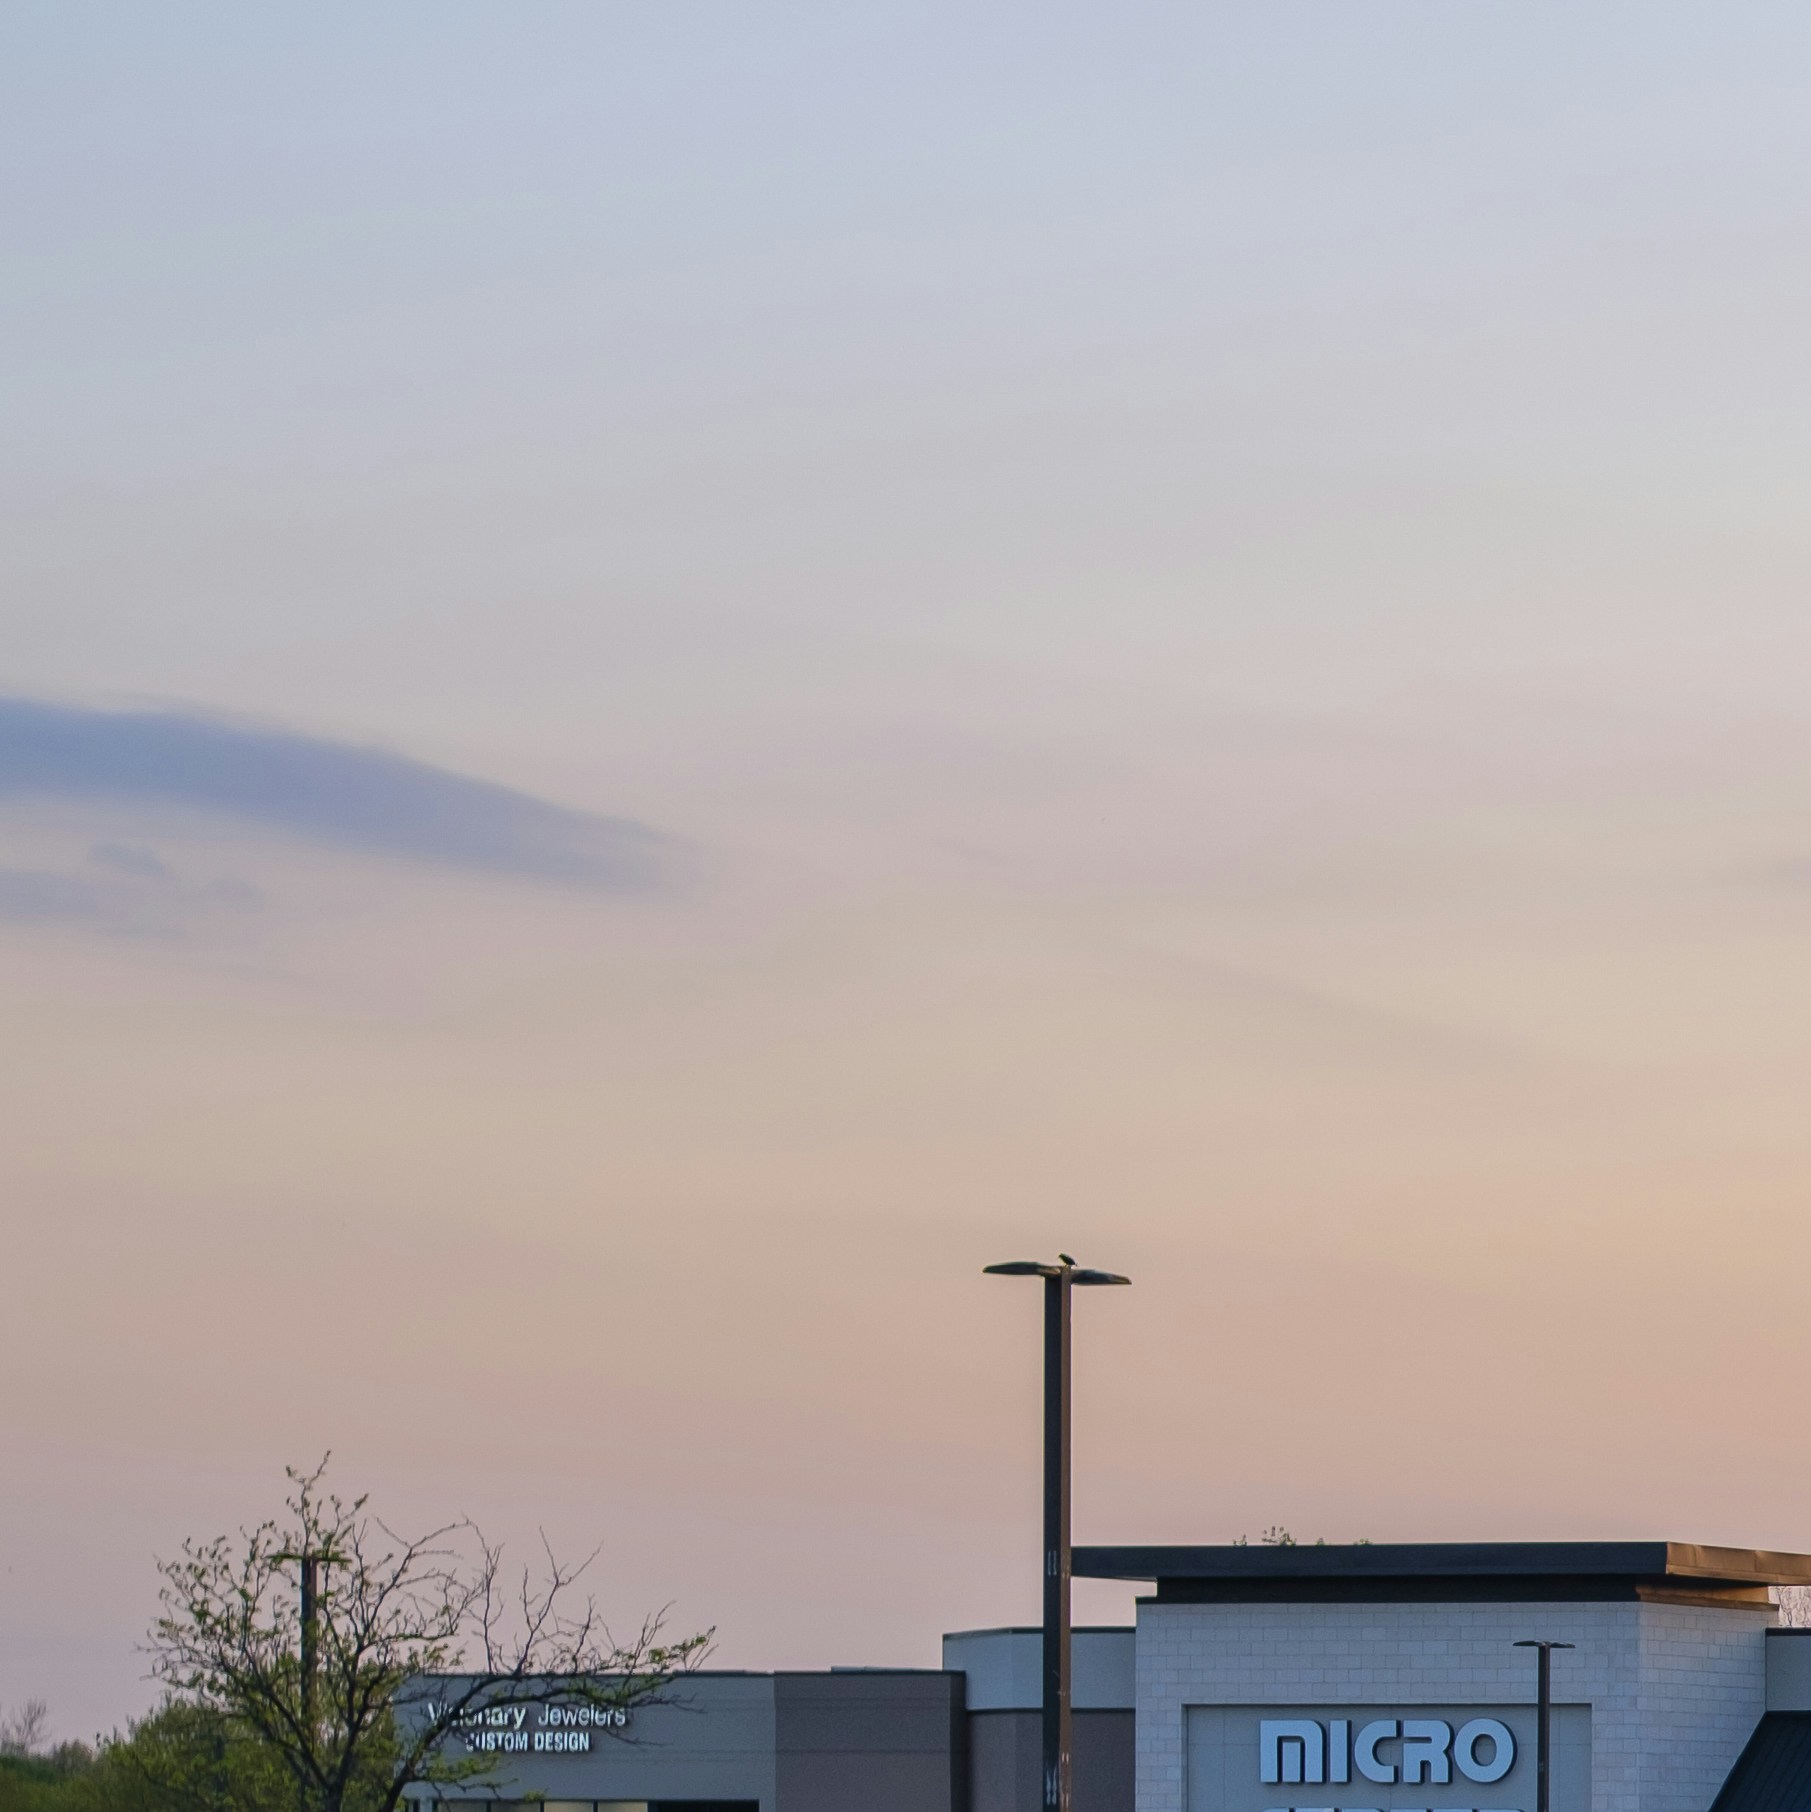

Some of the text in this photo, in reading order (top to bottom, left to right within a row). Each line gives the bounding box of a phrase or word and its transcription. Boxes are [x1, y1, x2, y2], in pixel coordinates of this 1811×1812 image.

[537, 1702, 627, 1727] Jewelers
[534, 1731, 591, 1752] DESIGN
[1259, 1717, 1517, 1784] MICRO
